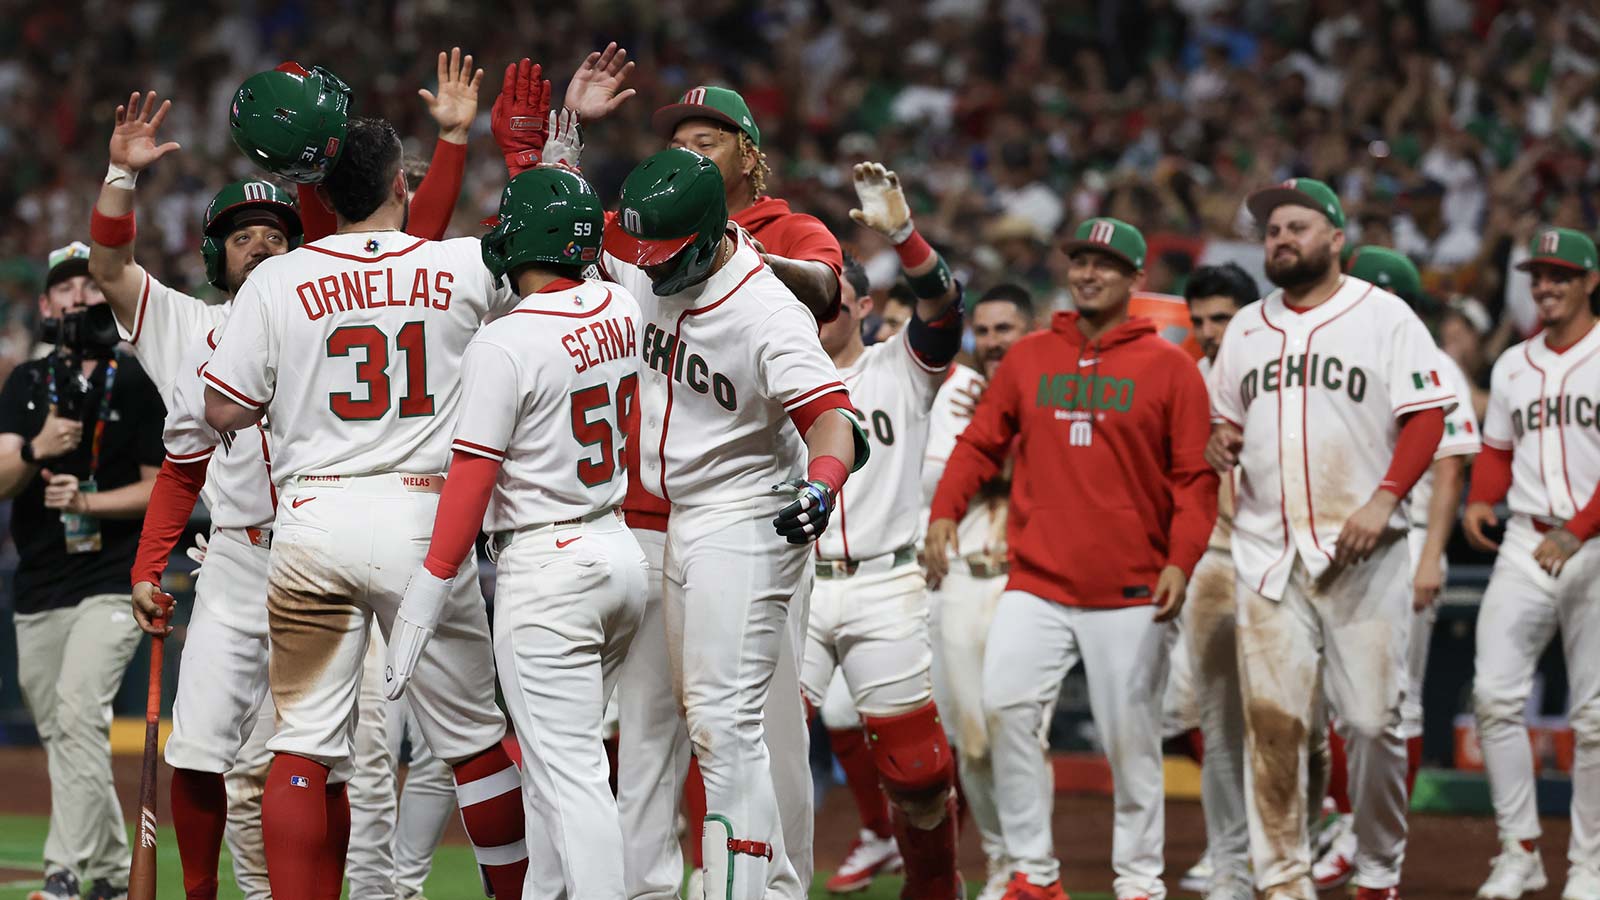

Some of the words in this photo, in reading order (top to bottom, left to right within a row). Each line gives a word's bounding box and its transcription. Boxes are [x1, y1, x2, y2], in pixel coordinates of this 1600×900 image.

[301, 146, 318, 162] 31
[573, 222, 592, 236] 59
[296, 267, 455, 321] ORNELAS
[561, 316, 637, 374] SERNA
[642, 322, 738, 412] EXICO
[326, 320, 435, 422] 31
[1035, 372, 1136, 413] MEXICO
[1239, 353, 1367, 410] MEXICO
[1510, 394, 1600, 440] MEXIC
[401, 476, 431, 487] NELAS
